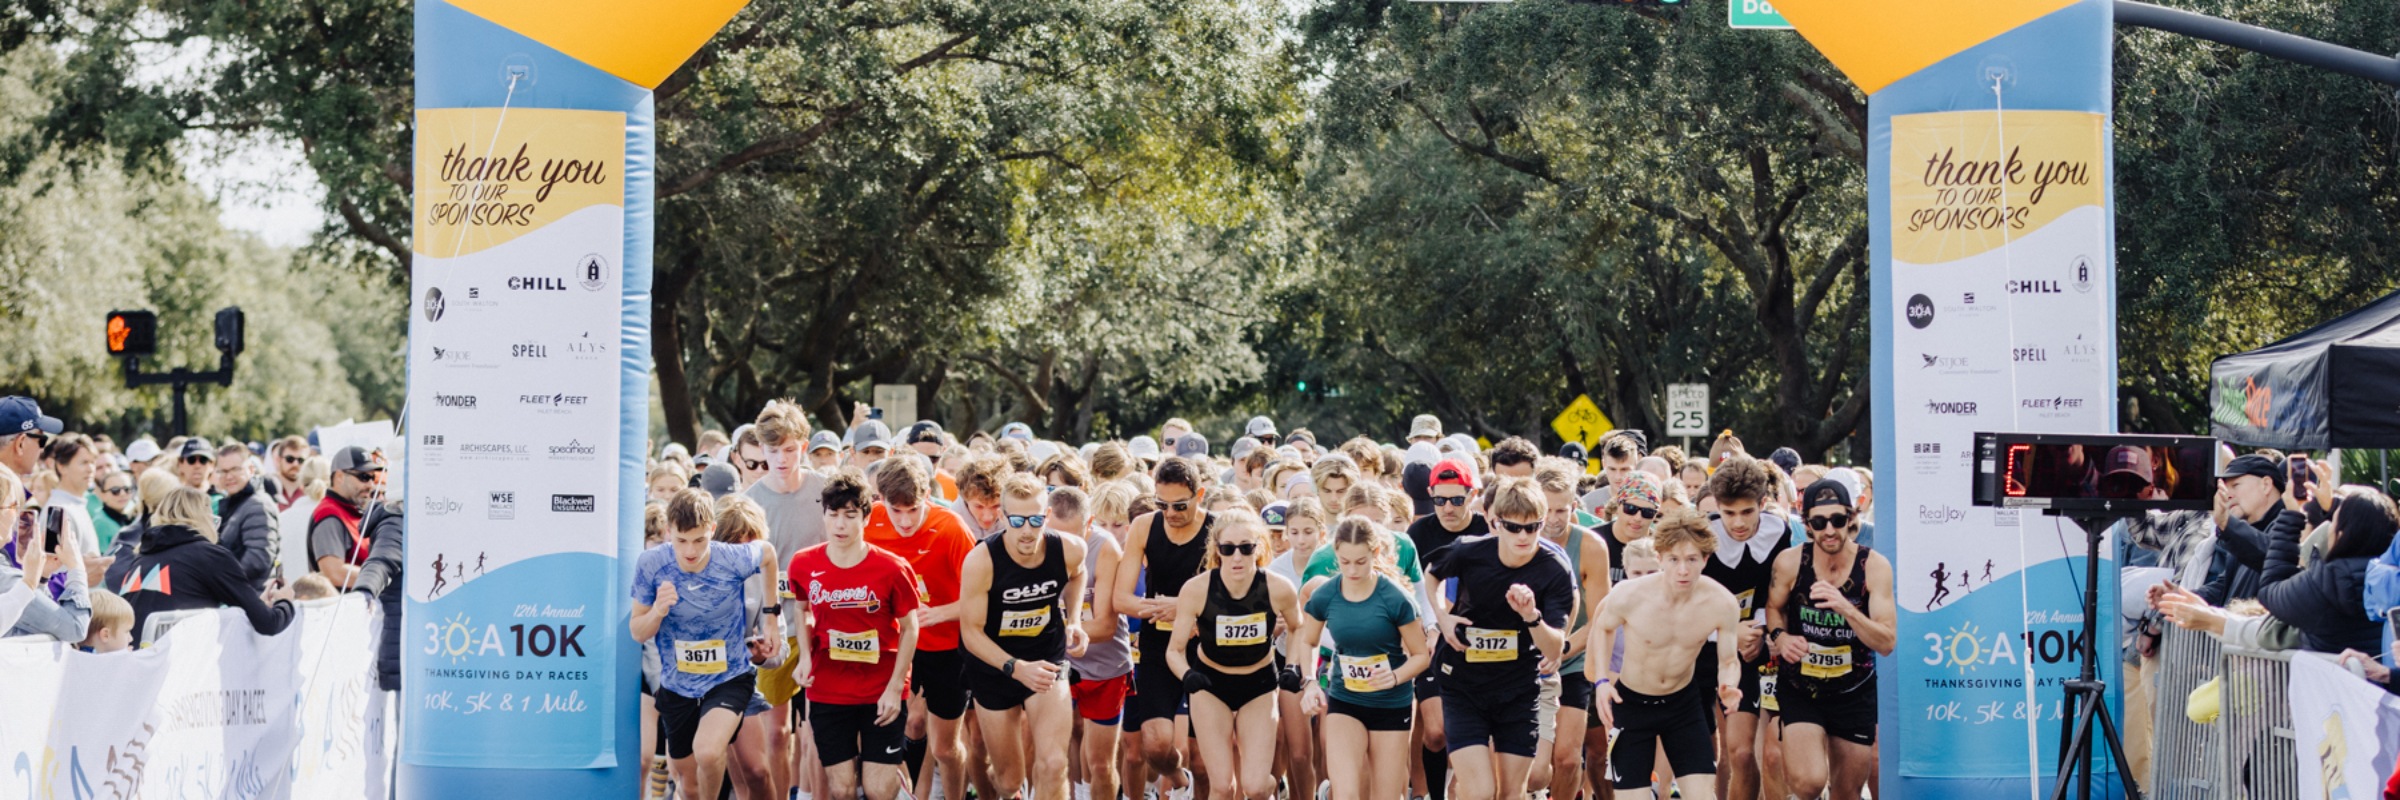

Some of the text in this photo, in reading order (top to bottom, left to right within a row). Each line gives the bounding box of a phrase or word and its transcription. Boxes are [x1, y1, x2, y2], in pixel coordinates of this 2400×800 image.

[441, 142, 606, 203] thank you
[1924, 145, 2089, 205] thank you
[449, 183, 508, 200] TO OUR
[1935, 187, 2002, 206] TO OUR
[428, 203, 535, 226] SPONSORS
[1907, 206, 2029, 232] SPONSORS
[508, 276, 567, 291] CHILL
[2005, 280, 2061, 294] CHILL
[1909, 303, 1932, 319] 30A
[512, 344, 547, 358] SPELL
[566, 342, 606, 353] ALYS
[2013, 348, 2046, 361] SPELL
[519, 395, 588, 405] FLEET FEET
[1675, 400, 1700, 409] LIMIT
[2022, 399, 2083, 408] FLEET FEET
[1933, 402, 1977, 414] YONDER
[1672, 411, 1704, 429] 25
[491, 493, 513, 503] WSE
[554, 496, 592, 505] Blackwell
[809, 580, 868, 605] Braves
[513, 604, 585, 618] 12th Annual
[1800, 605, 1845, 627] ATLAN
[2050, 609, 2085, 624] Annua
[1009, 616, 1042, 629] 4192
[1225, 625, 1258, 638] 3725
[1802, 623, 1832, 637] SNACK
[424, 614, 587, 664] 30A 10K
[836, 638, 872, 651] 3202
[1476, 637, 1507, 650] 3172
[1923, 621, 2085, 675] 30A 10K
[685, 649, 717, 662] 3671
[1809, 652, 1844, 666] 3795
[425, 668, 588, 681] THANKSGIVING DAY RACES
[1925, 678, 2022, 689] THANKSGIVING
[424, 689, 587, 715] 10K, 5K & 1 Mile
[1926, 700, 1968, 722] 10K,
[1974, 700, 2005, 724] 5K
[2013, 701, 2026, 720] &
